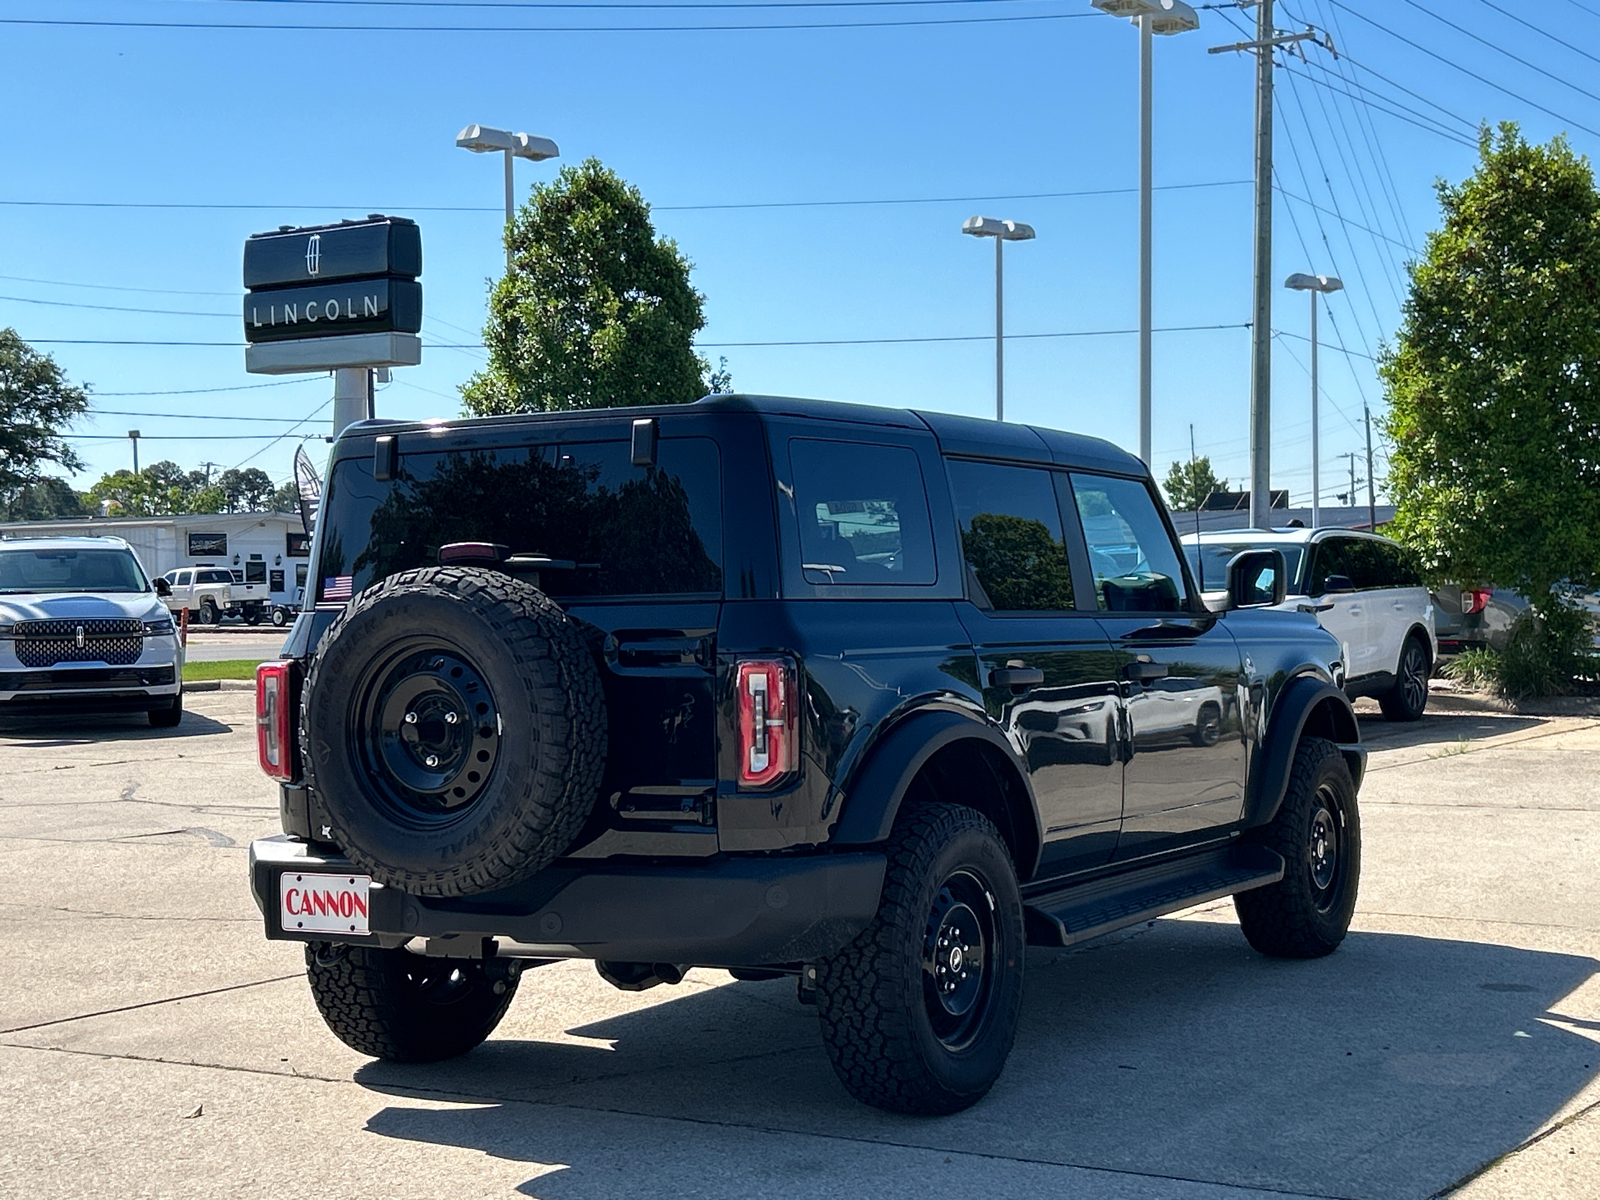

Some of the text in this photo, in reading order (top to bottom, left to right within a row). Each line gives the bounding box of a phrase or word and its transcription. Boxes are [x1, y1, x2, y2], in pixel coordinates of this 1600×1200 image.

[252, 294, 379, 328] LINCOLN
[317, 617, 377, 730] GRABBER
[435, 760, 519, 859] GENERAL
[285, 887, 367, 919] CANNON
